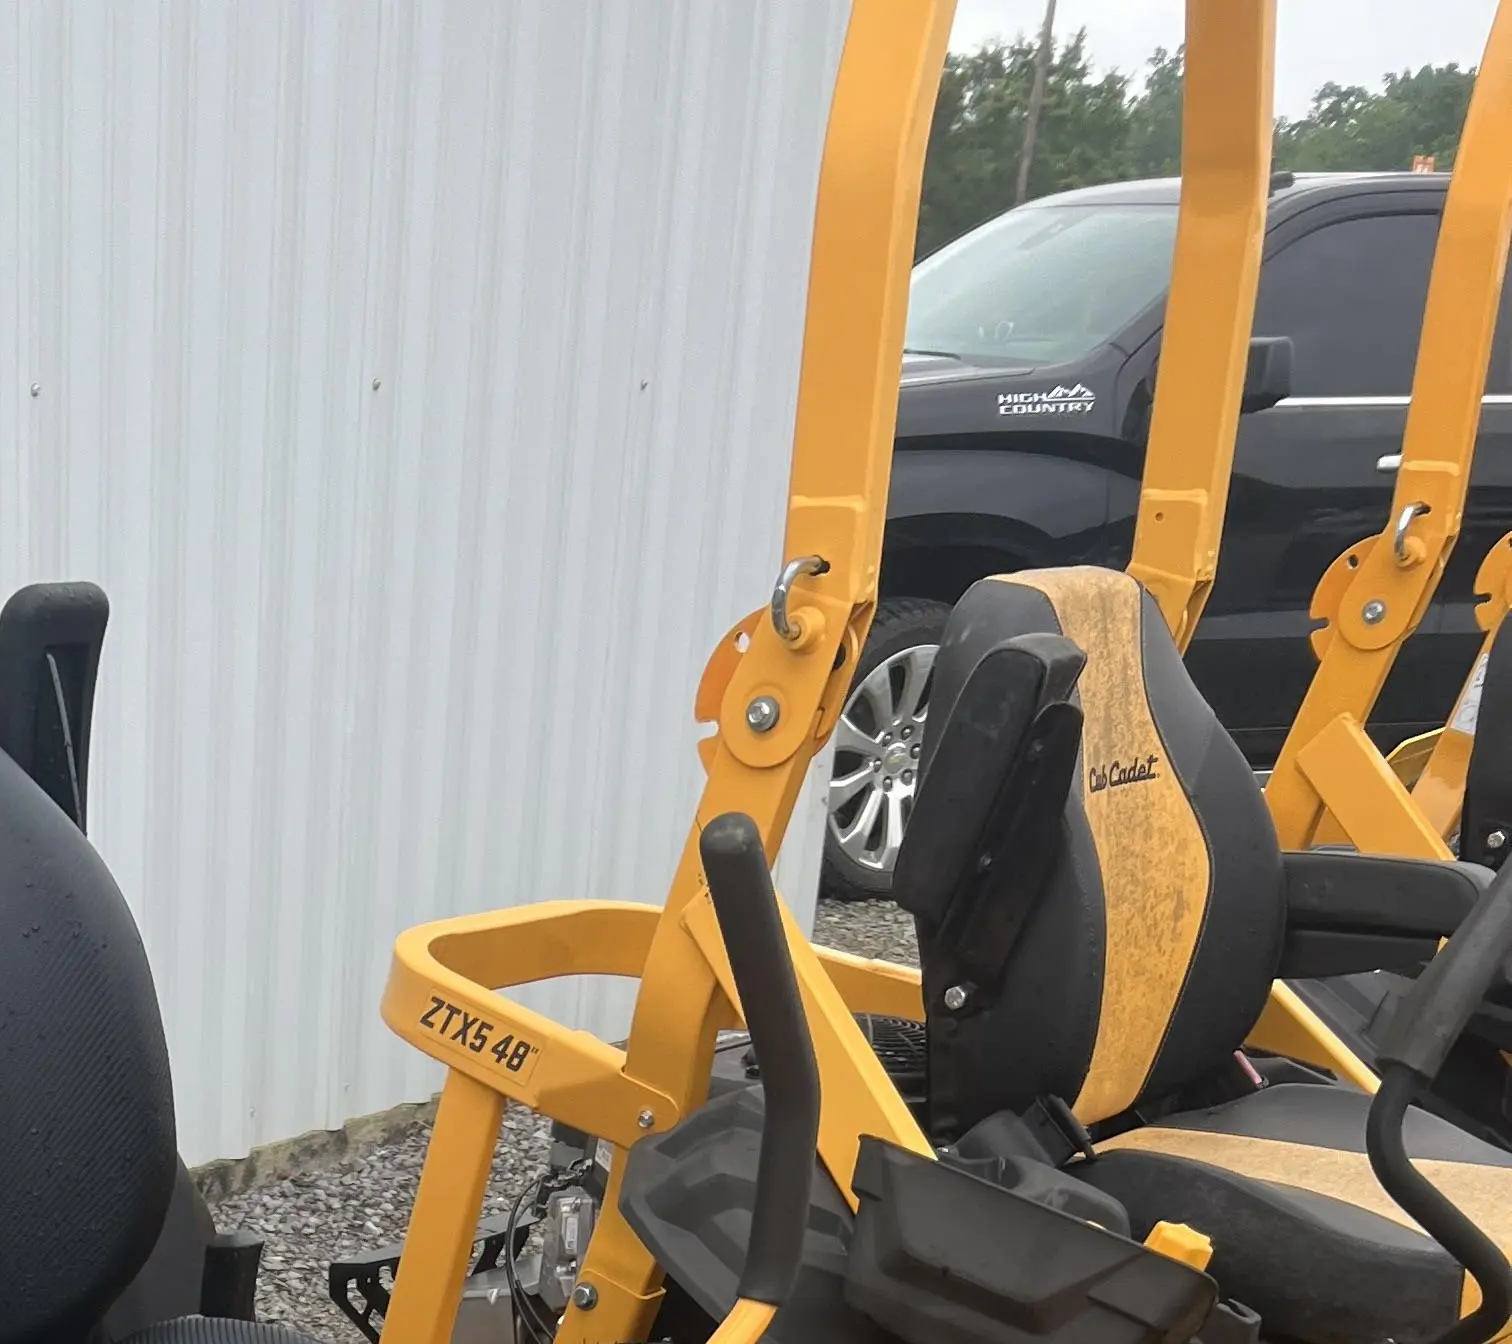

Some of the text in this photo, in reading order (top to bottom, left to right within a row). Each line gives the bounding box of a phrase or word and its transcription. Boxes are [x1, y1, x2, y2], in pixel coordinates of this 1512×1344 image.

[998, 393, 1048, 404] HIGH
[999, 402, 1096, 415] COUNTRY
[1089, 753, 1159, 793] Cub Cadet
[419, 996, 494, 1053] ZTX5
